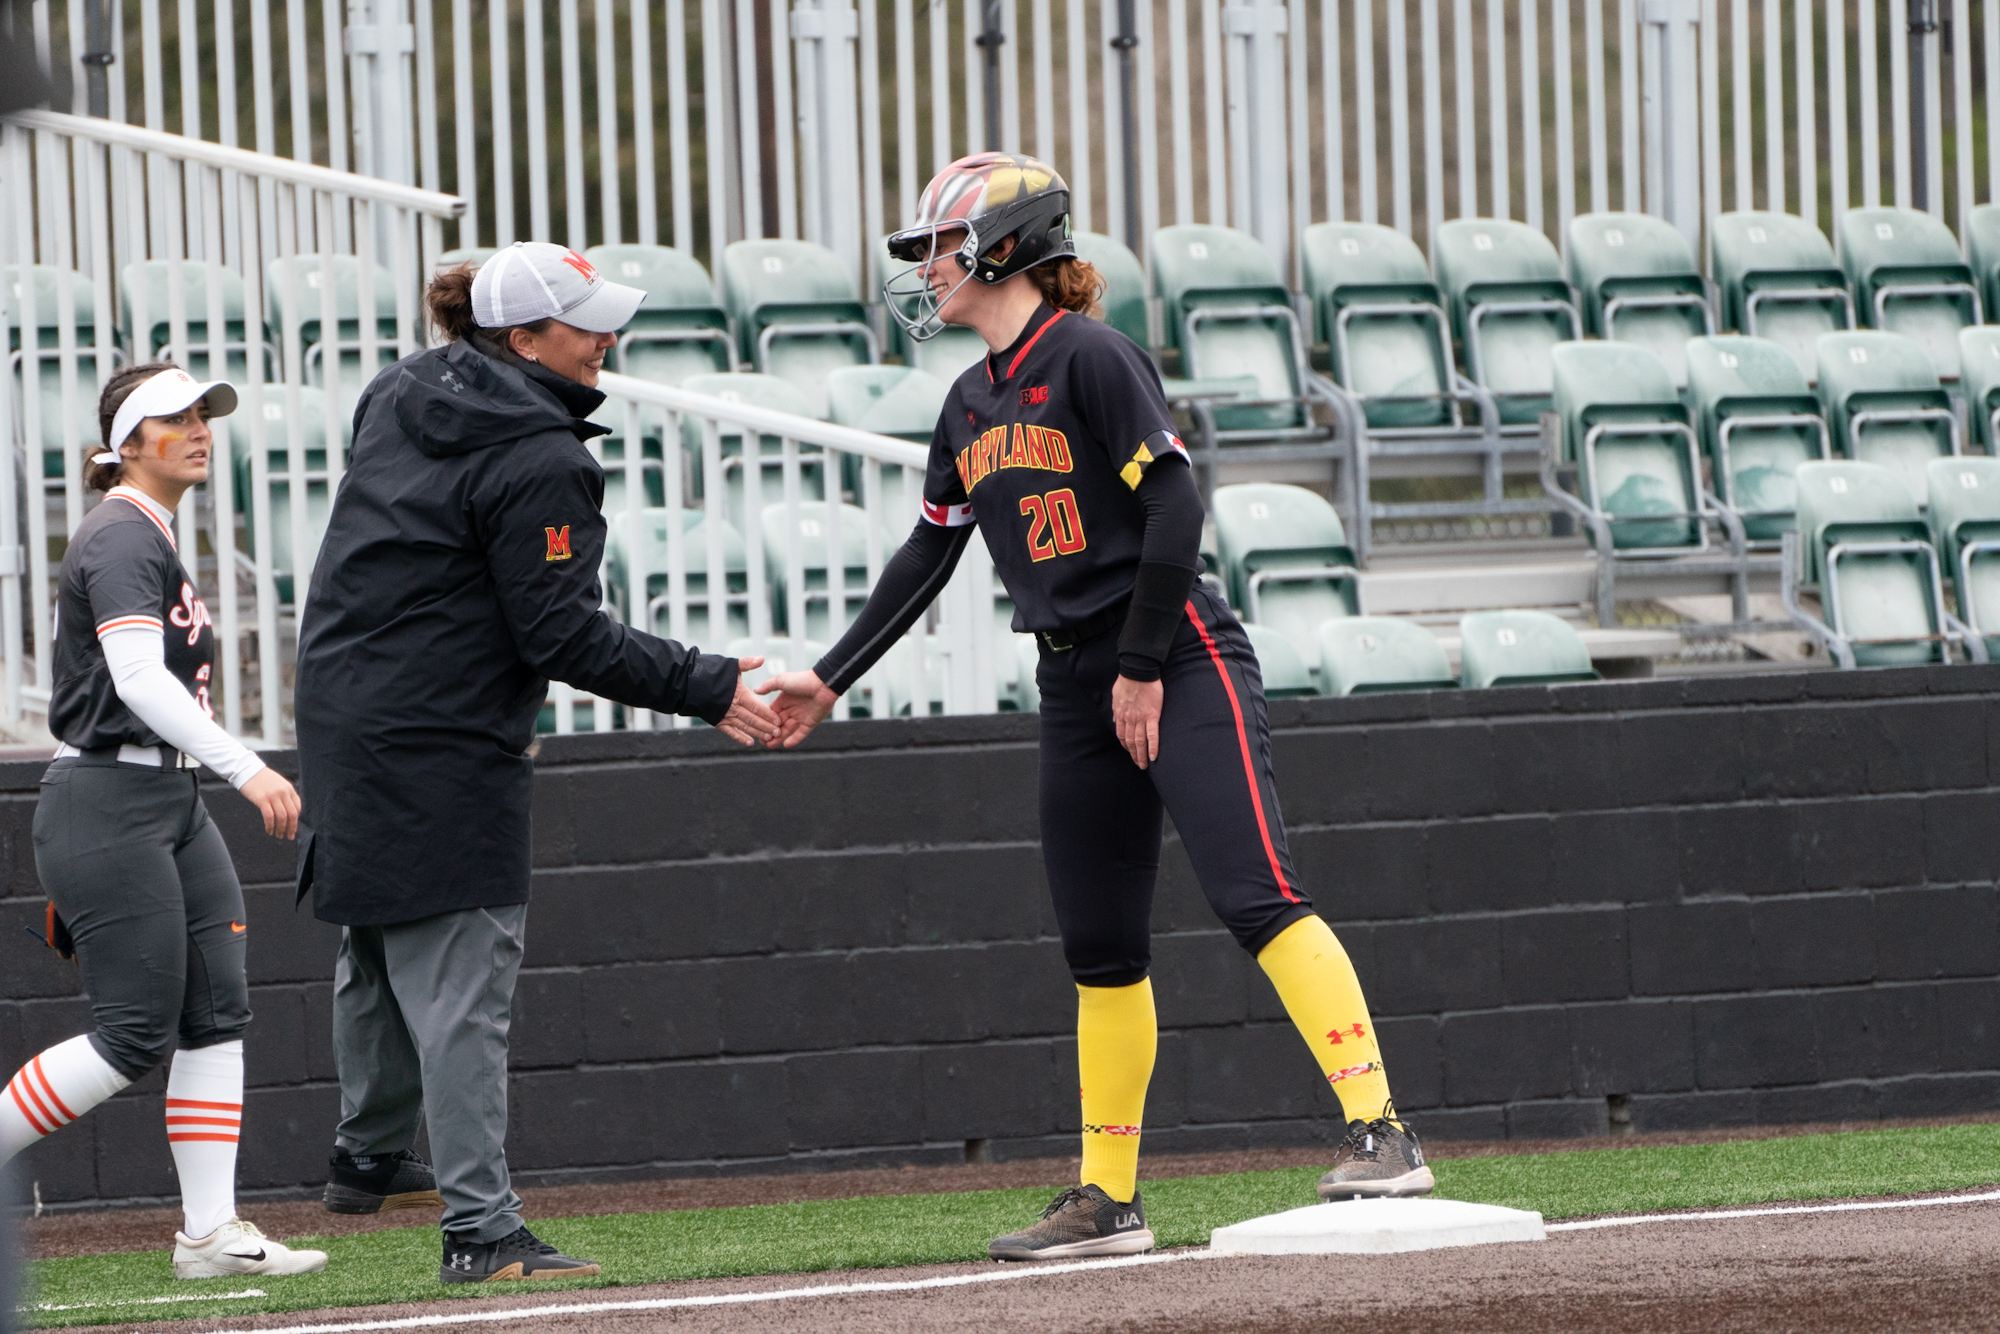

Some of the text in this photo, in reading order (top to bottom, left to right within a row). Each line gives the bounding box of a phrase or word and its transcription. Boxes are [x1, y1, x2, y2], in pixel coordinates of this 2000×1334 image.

[562, 249, 596, 281] M
[955, 423, 1073, 499] MARYLAND
[545, 525, 572, 556] M
[1019, 488, 1087, 563] 20
[1115, 1212, 1141, 1229] UA
